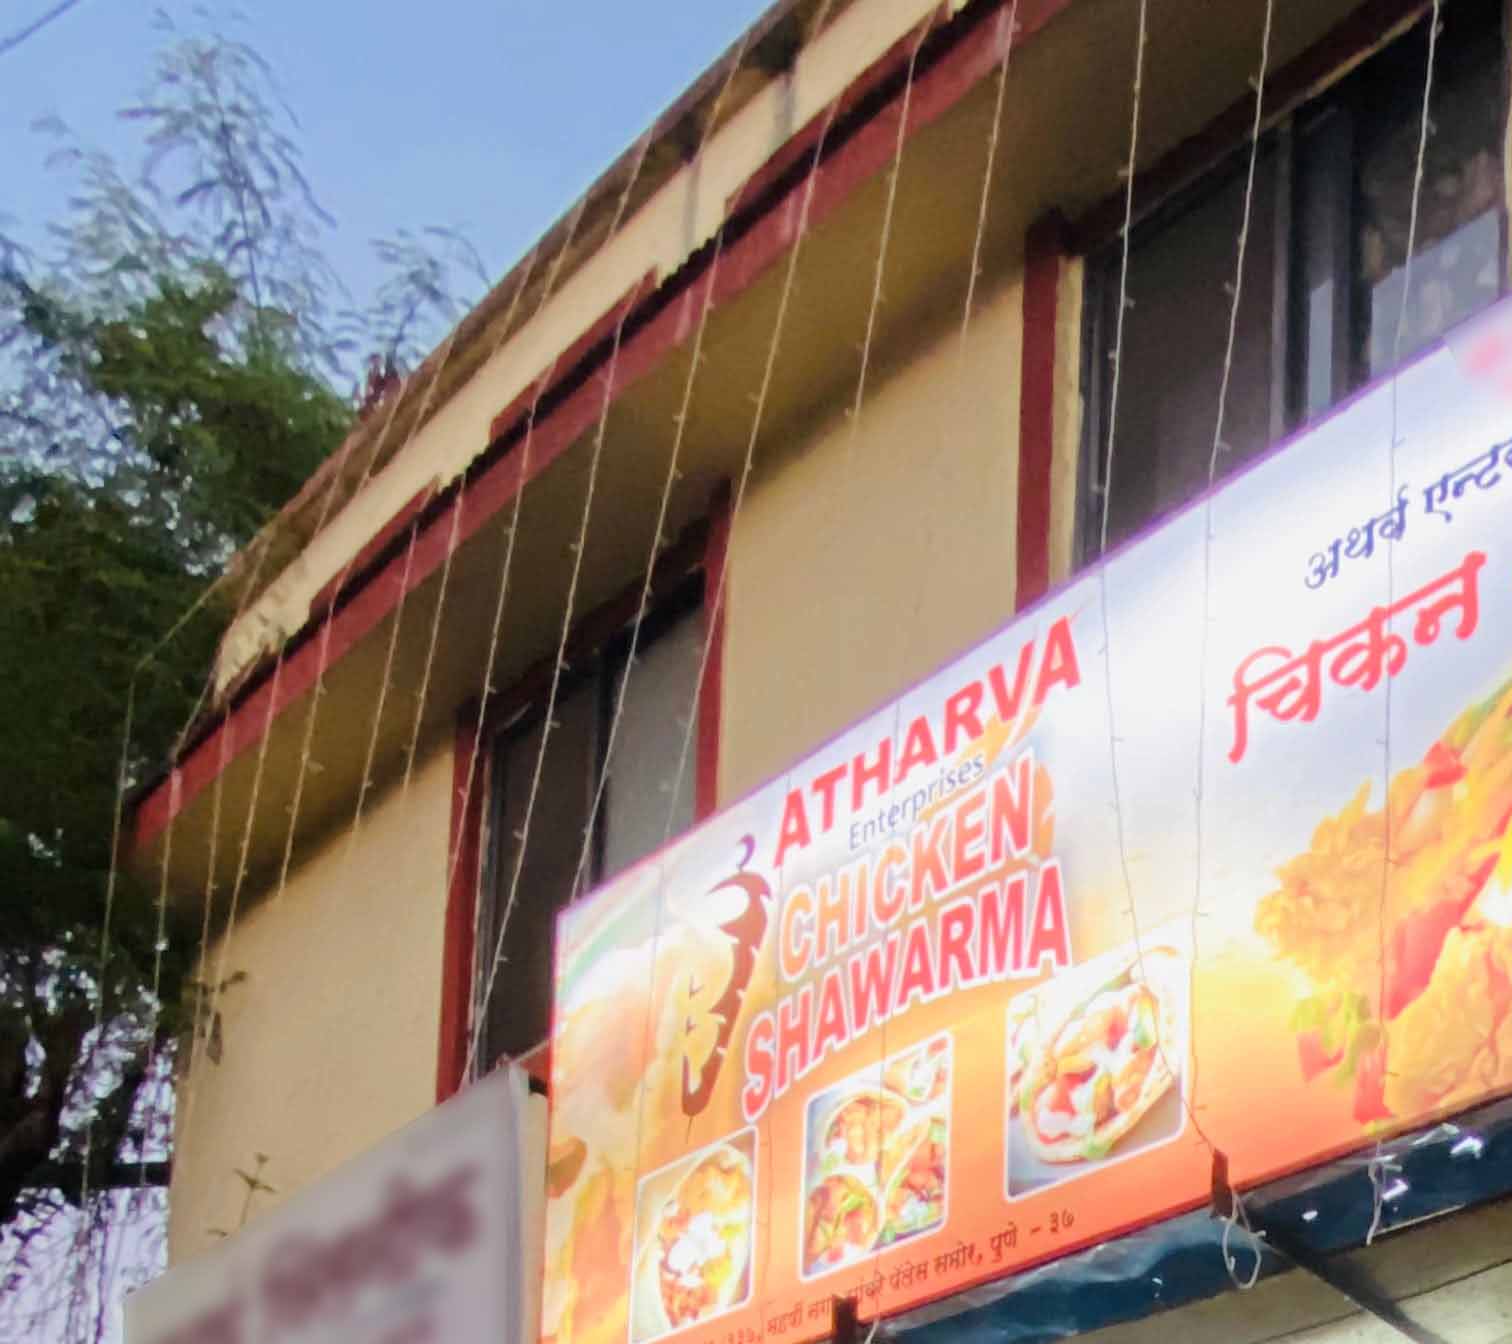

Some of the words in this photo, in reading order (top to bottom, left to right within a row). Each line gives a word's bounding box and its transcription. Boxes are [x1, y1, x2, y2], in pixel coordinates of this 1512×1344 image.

[1303, 482, 1410, 590] अथर्व
[774, 615, 1081, 868] ATHARVA
[1228, 550, 1487, 765] चिकन
[780, 755, 1032, 980] CHICKEN
[847, 752, 984, 851] Enterprises
[741, 863, 1069, 1119] SHAWARMA
[989, 1221, 1018, 1264] पुणे
[1049, 1208, 1075, 1234] ३७
